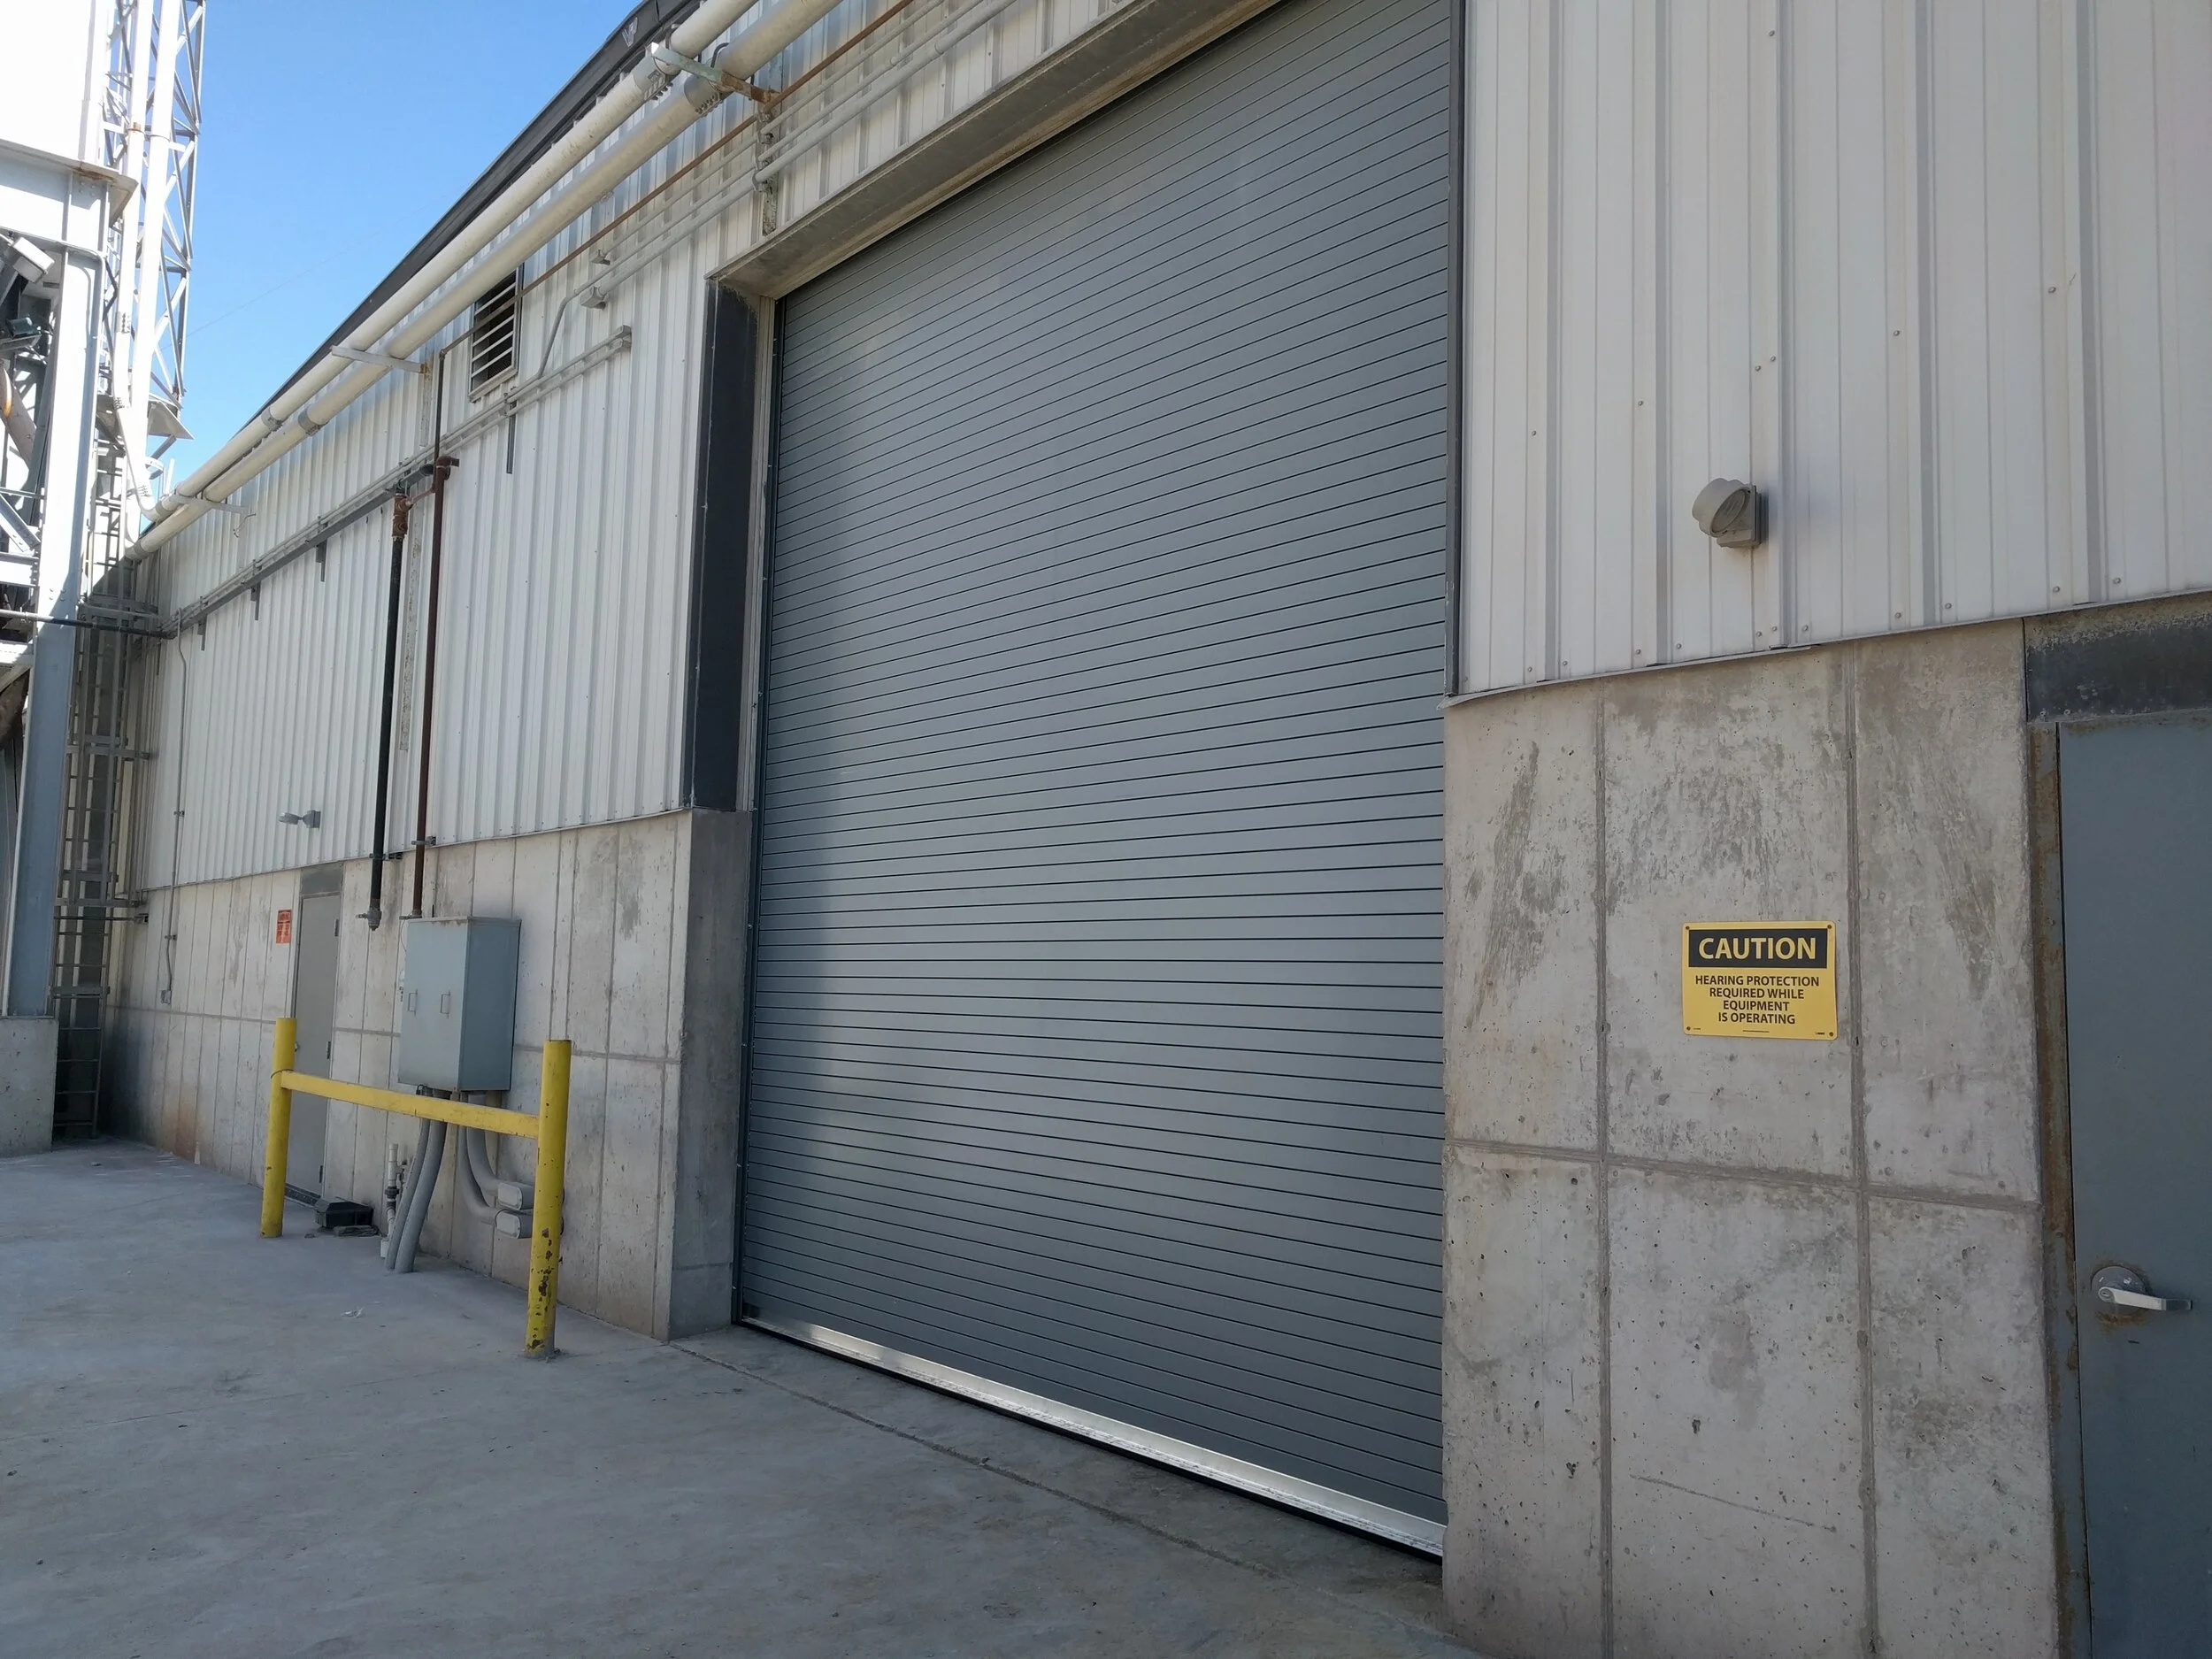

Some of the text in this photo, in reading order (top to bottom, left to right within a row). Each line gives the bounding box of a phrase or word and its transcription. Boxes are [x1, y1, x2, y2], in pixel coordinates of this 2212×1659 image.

[1699, 938, 1816, 960] CAUTION
[1695, 975, 1819, 987] HEARING PROTECTION
[1709, 988, 1803, 999] REQUIRED WHILE
[1724, 1001, 1789, 1011] EQUIPMENT
[1718, 1012, 1795, 1024] IS OPERATING
